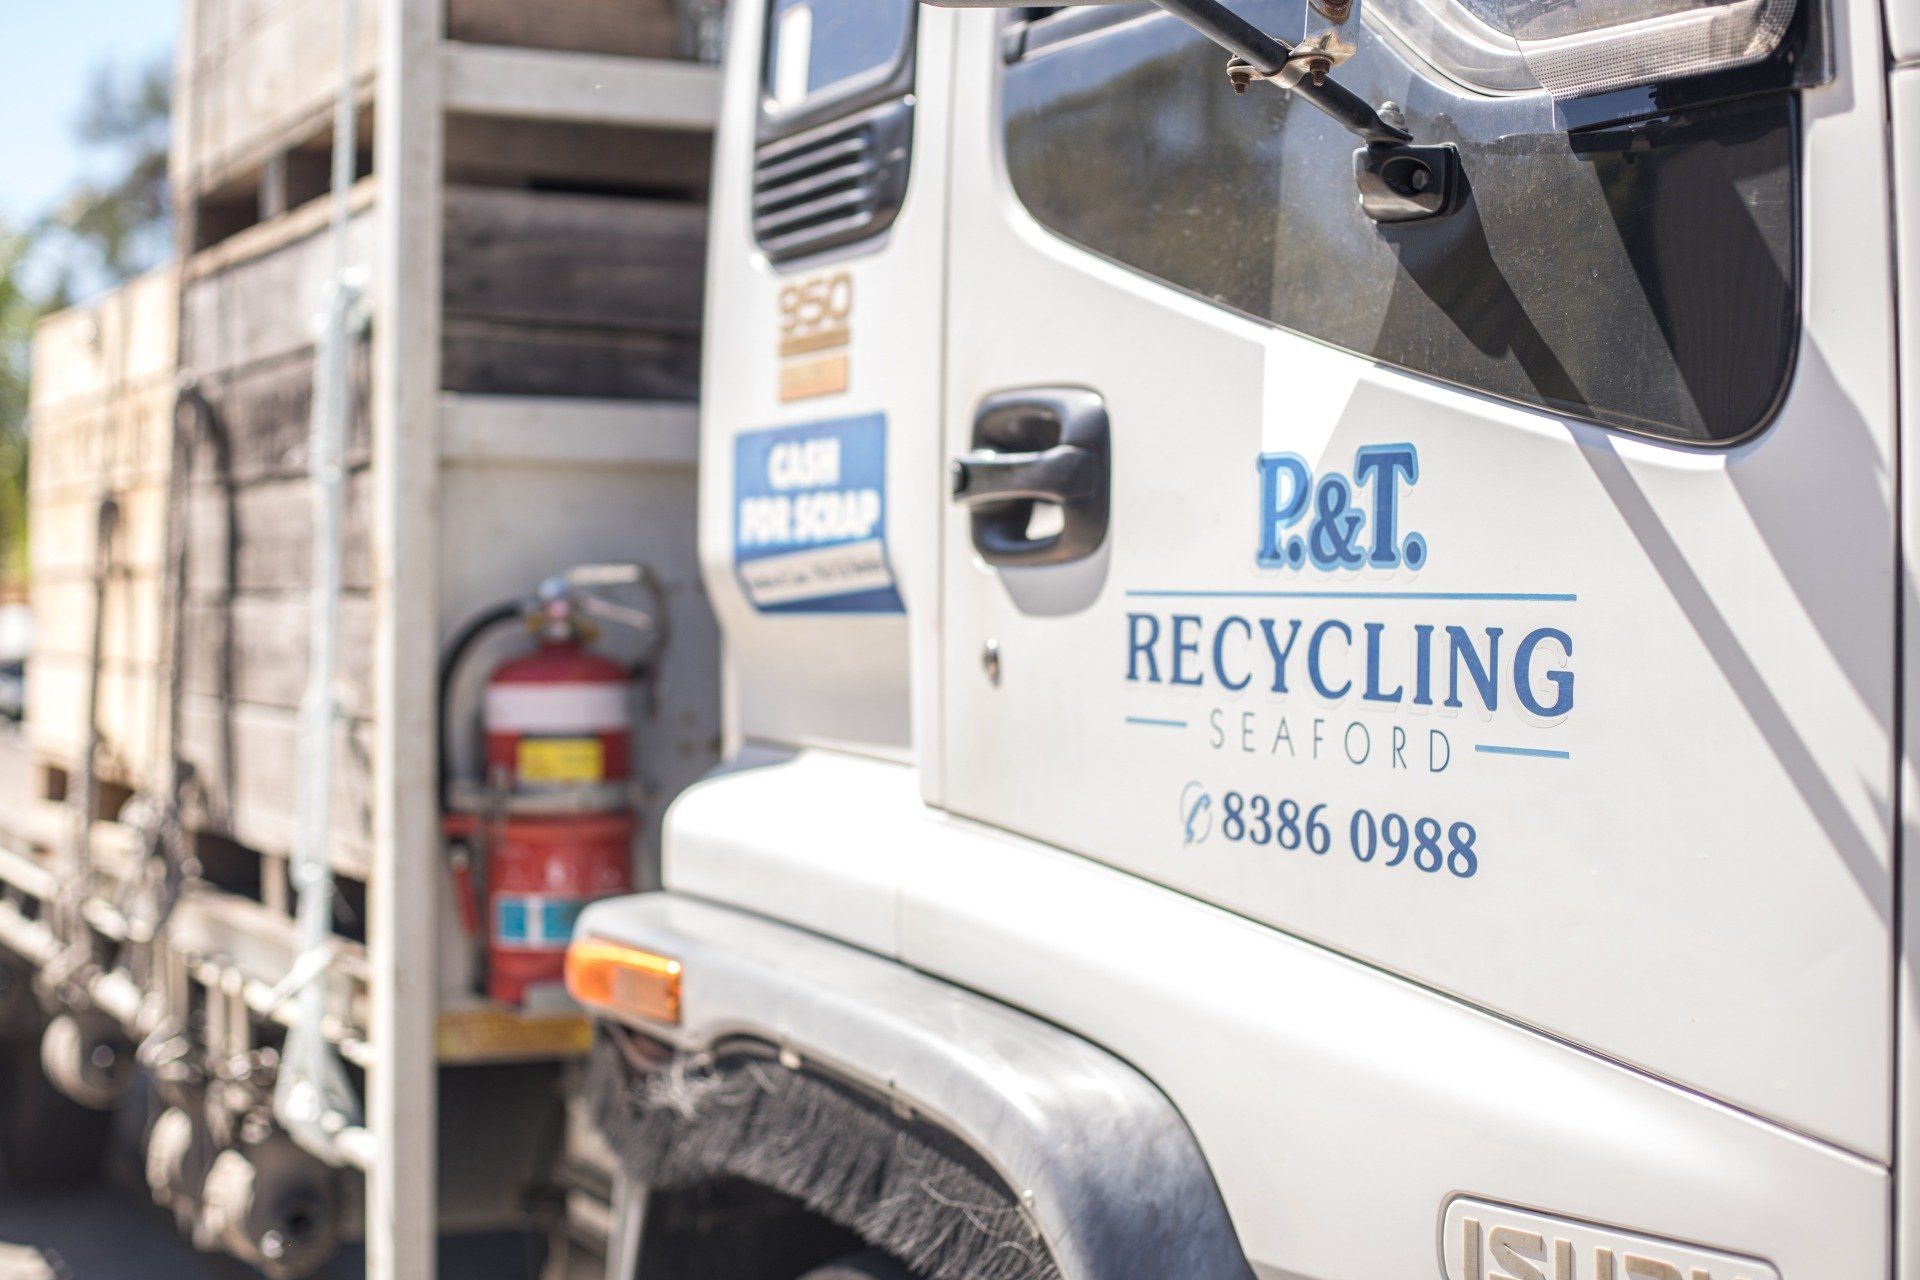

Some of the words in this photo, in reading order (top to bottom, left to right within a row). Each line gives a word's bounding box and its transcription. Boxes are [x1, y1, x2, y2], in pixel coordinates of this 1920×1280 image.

[1125, 612, 1576, 718] RECYCLING
[1209, 708, 1451, 773] SEAFORD
[1221, 790, 1332, 856] 8386
[1349, 808, 1479, 879] 0988
